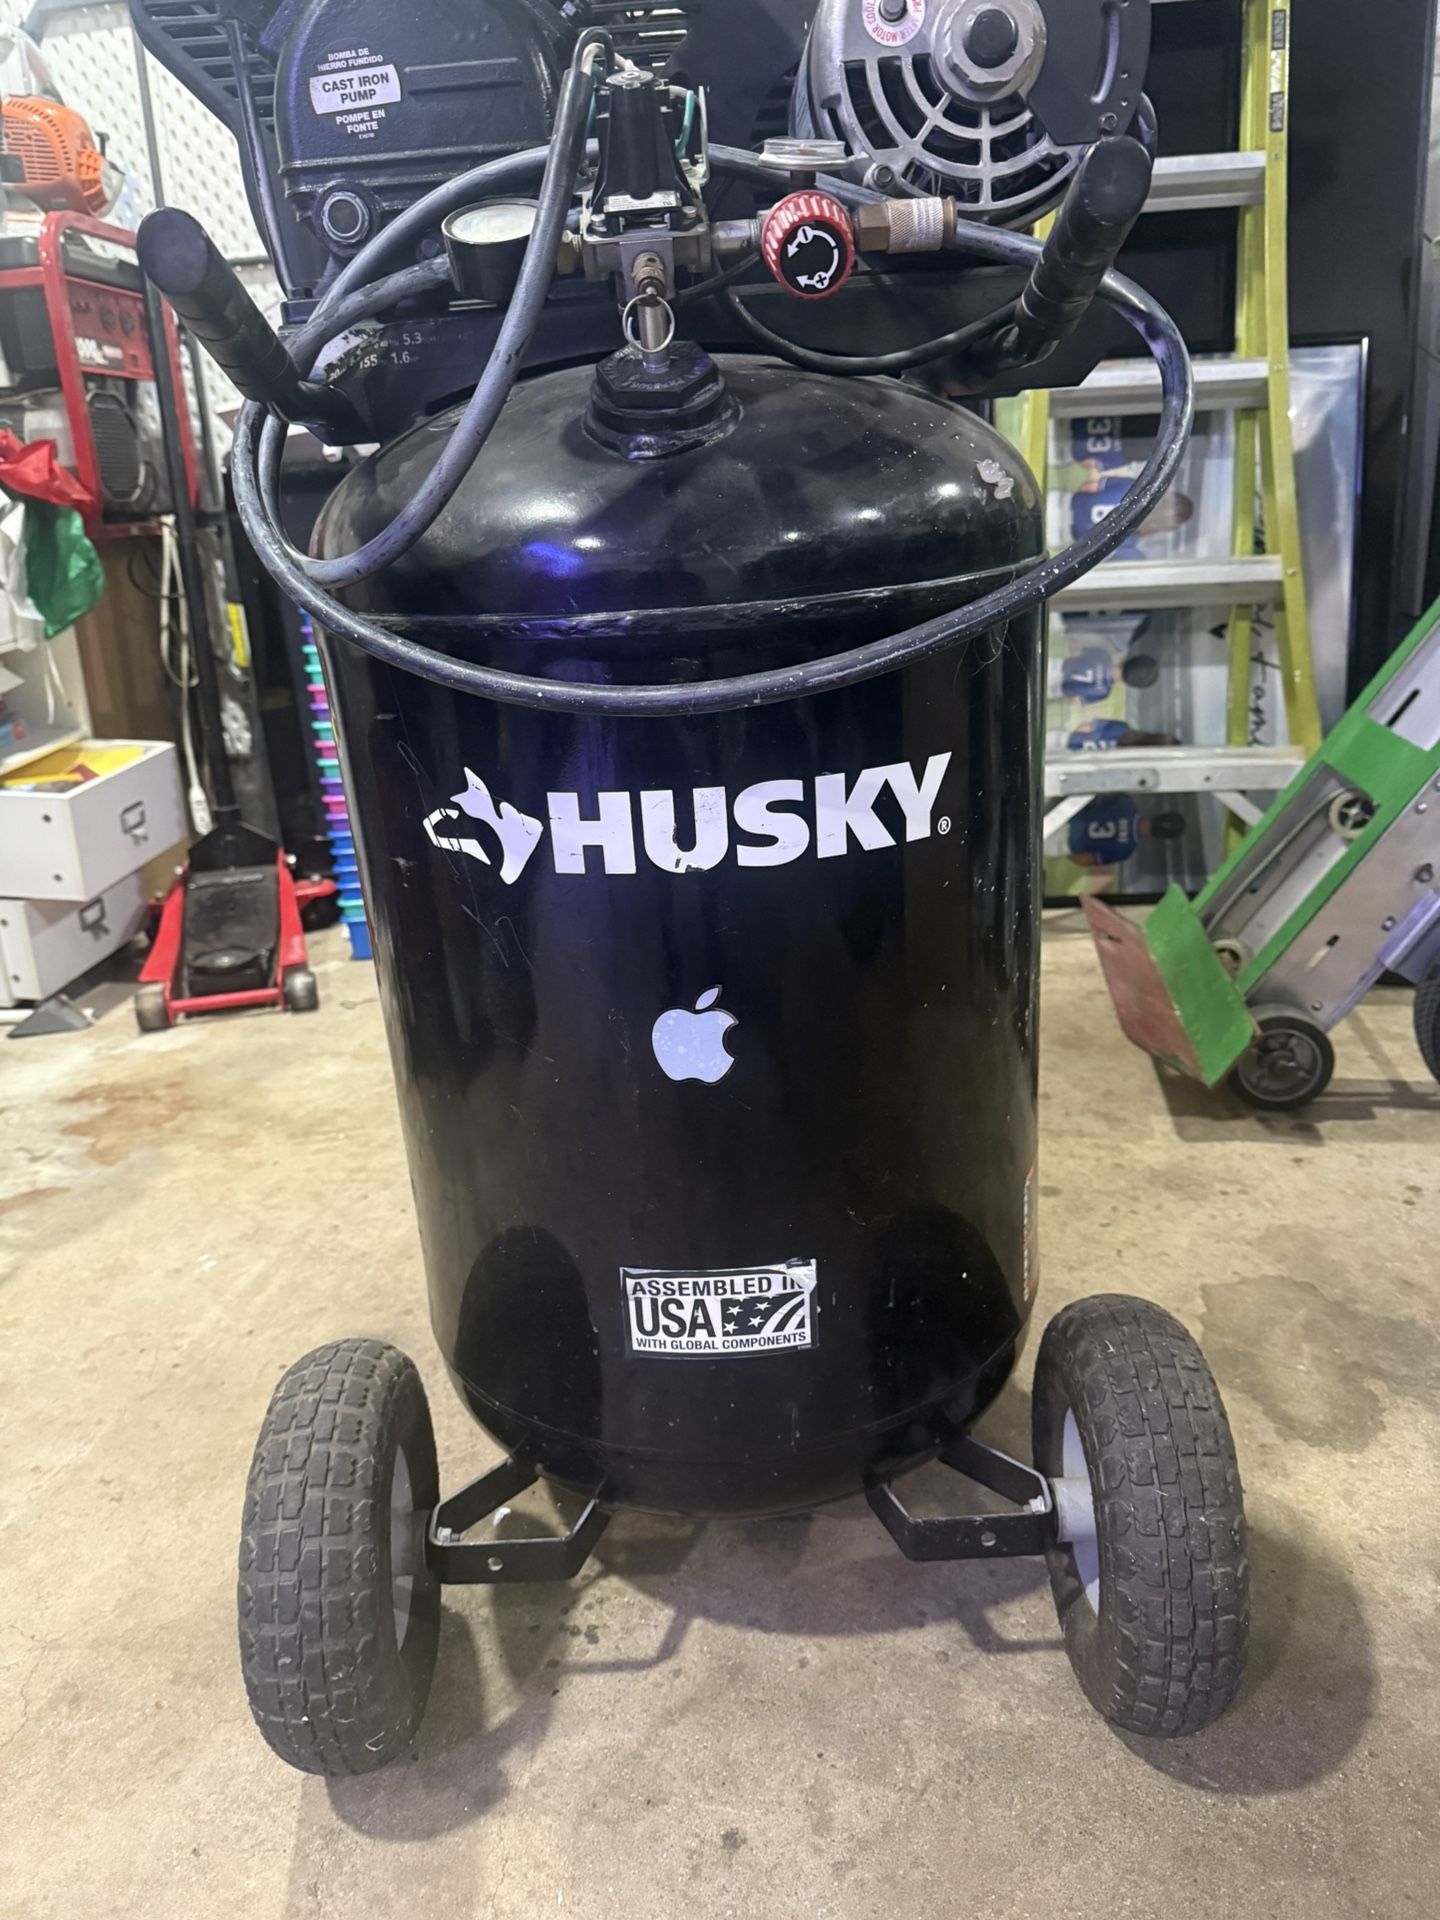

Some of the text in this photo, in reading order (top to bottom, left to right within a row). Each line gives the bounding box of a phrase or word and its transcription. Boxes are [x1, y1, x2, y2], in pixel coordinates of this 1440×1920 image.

[872, 23, 898, 43] MOTOR
[318, 54, 383, 71] HIERRO FUNDIDO
[328, 47, 370, 60] BOMBA DE
[322, 72, 389, 93] CAST IRON
[340, 88, 377, 104] PUMP
[336, 109, 386, 125] POMPE EN
[347, 121, 379, 134] FONTE
[402, 332, 422, 346] 5.3
[390, 350, 410, 364] 1.6
[1086, 419, 1113, 454] 33
[1087, 820, 1117, 839] 3
[631, 1276, 773, 1296] ASSEMBLED
[635, 1296, 716, 1338] USA
[636, 1331, 807, 1350] WITH GLOBAL COMPONENTS
